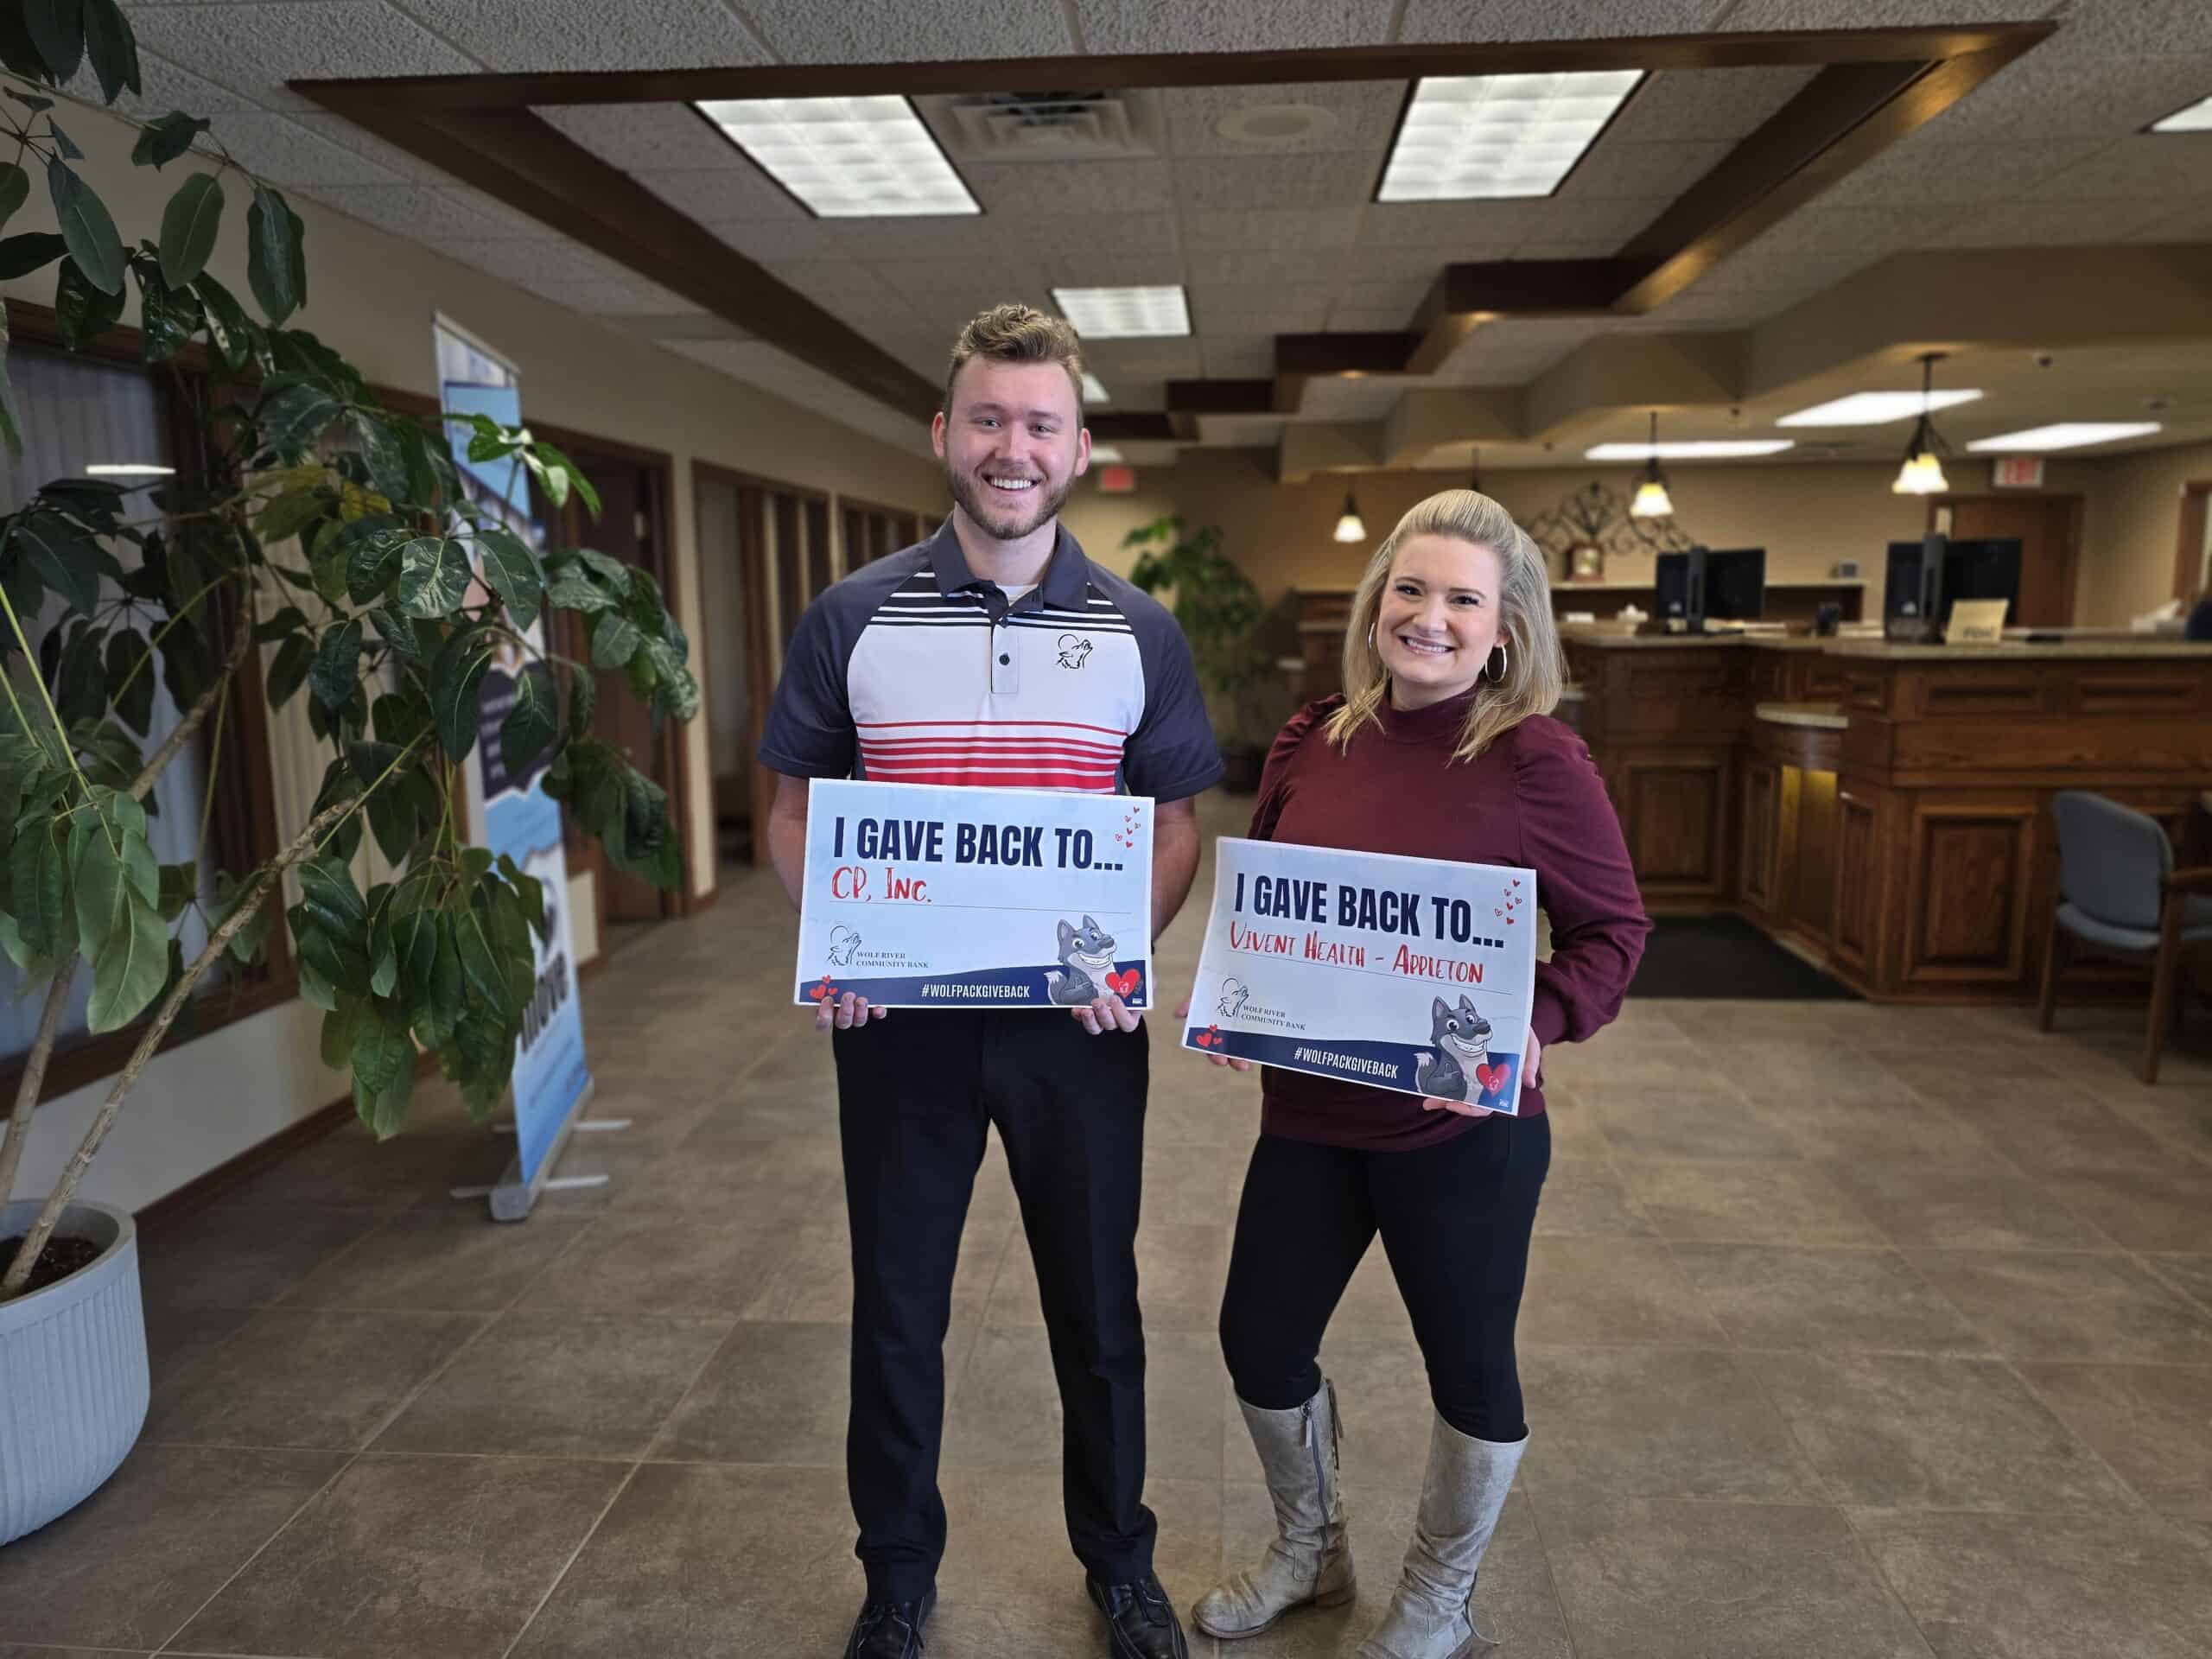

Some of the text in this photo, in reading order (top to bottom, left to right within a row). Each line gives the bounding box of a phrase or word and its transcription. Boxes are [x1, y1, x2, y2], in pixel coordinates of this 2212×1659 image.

[834, 817, 1123, 871] I GAVE BACK TO...
[1235, 874, 1504, 949] I GAVE BACK TO...
[1230, 920, 1296, 956] VIVENT
[1304, 931, 1364, 968] HEALTH
[1392, 944, 1484, 984] APPLETON
[922, 984, 1029, 997] #WOLFPACKGIVEBACK
[1242, 1014, 1306, 1030] COMMUNITY BANK
[1243, 1005, 1286, 1018] WOLF RIVER
[1294, 1047, 1398, 1078] #WOLFPACKGIVEBACK
